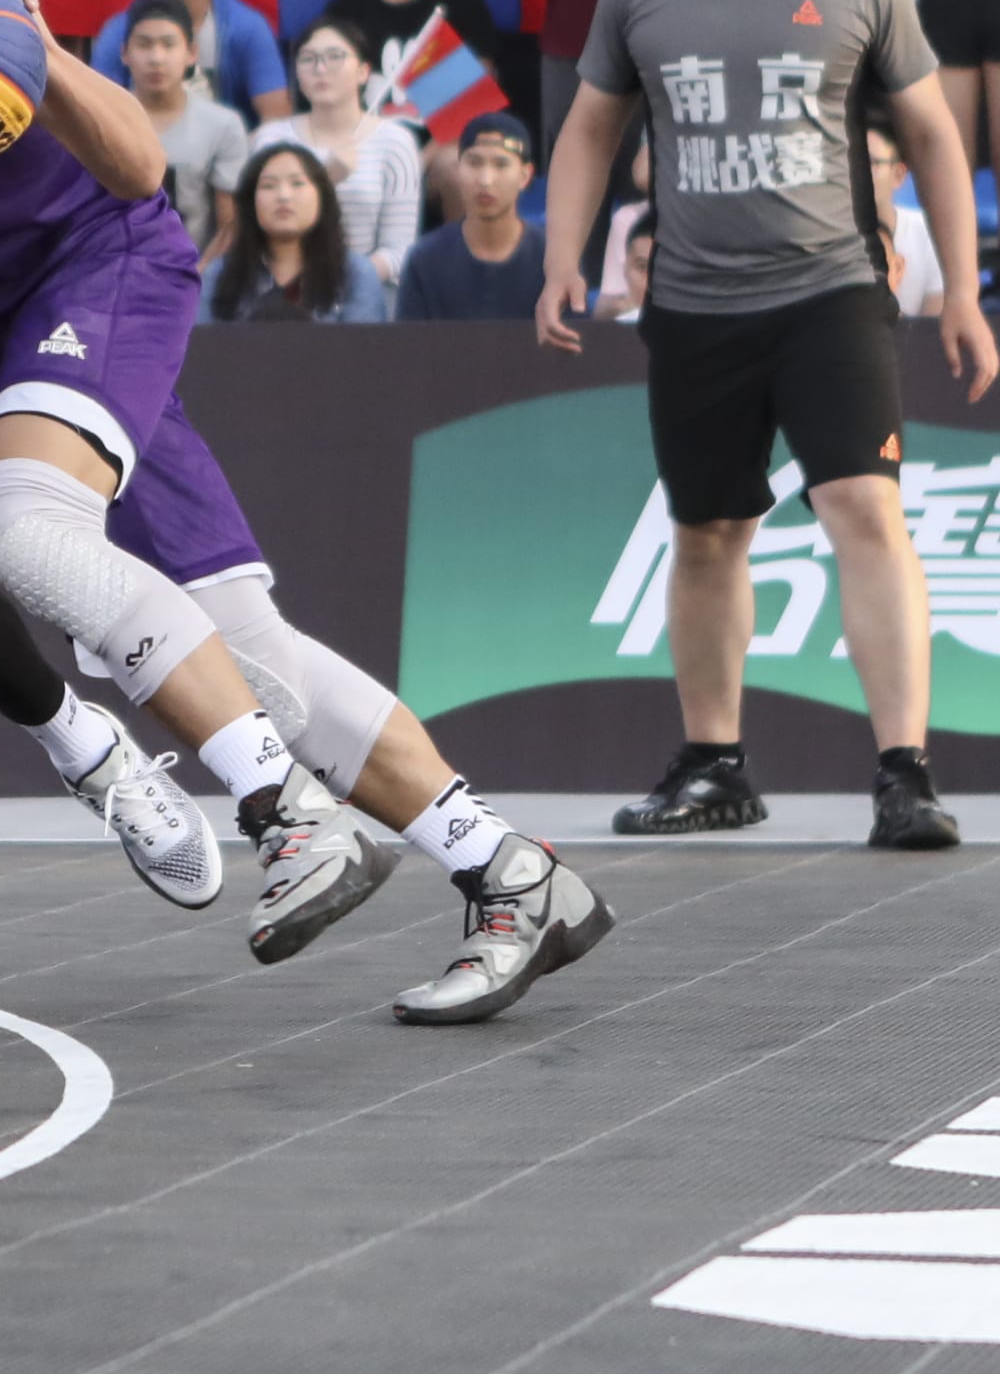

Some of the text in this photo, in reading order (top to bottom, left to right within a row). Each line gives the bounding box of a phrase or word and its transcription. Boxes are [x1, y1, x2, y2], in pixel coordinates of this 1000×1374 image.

[659, 53, 825, 123] 南京
[677, 131, 827, 194] 挑战赛
[443, 814, 482, 850] PEAK
